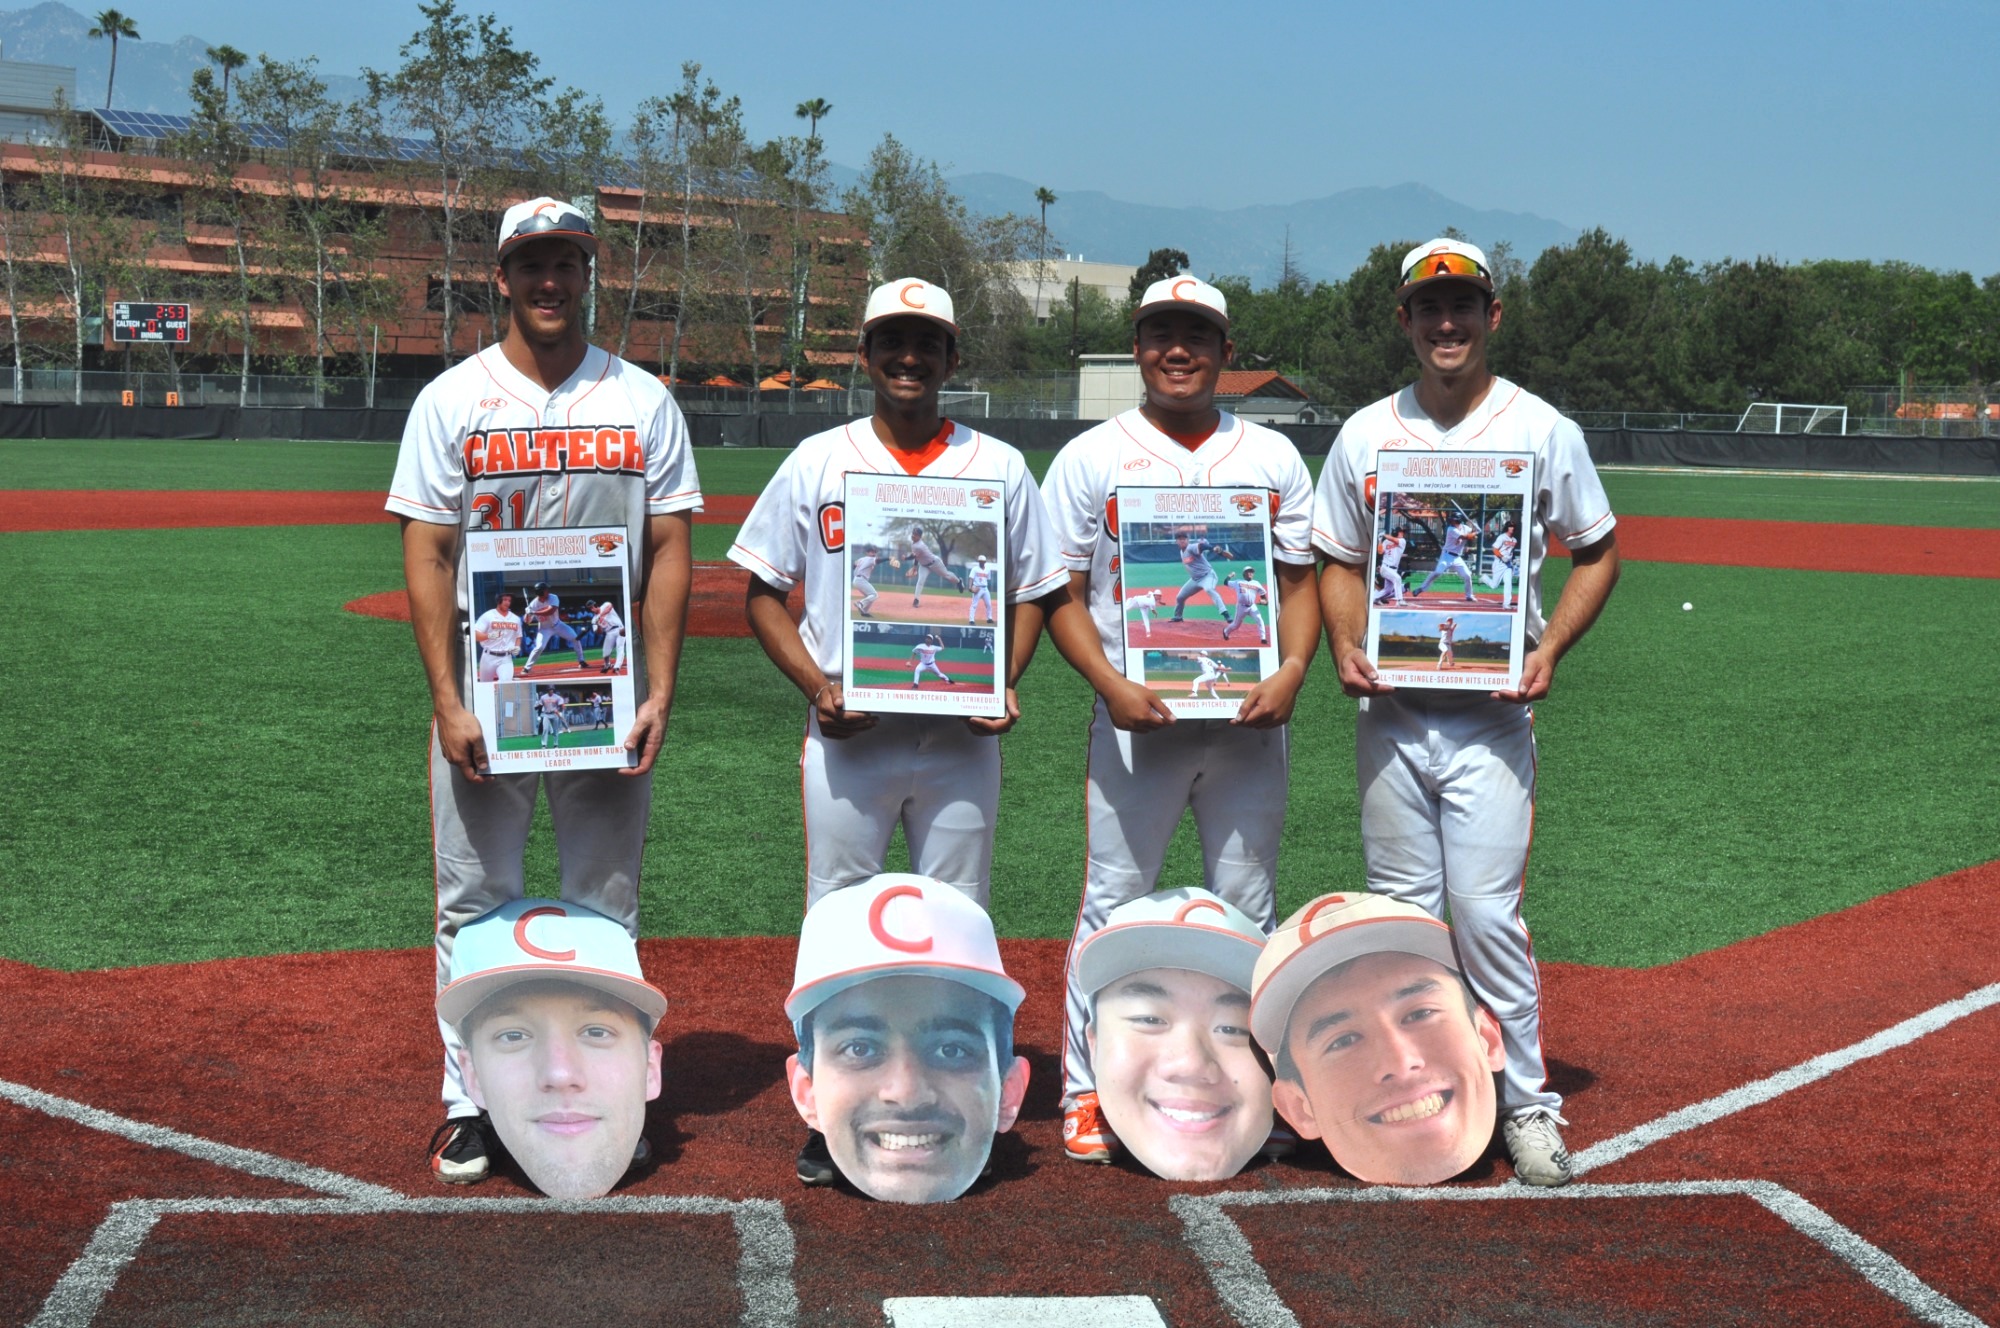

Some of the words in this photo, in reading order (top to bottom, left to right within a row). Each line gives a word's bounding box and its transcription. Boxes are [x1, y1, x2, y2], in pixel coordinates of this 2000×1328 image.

[899, 283, 925, 309] C
[1172, 280, 1197, 302] C
[156, 306, 185, 319] 2:53
[140, 331, 163, 339] INNING
[147, 320, 156, 332] 0
[165, 321, 187, 329] GUEST
[176, 327, 185, 341] 8
[462, 426, 645, 482] CALTECH
[1403, 457, 1438, 477] JACK
[1440, 458, 1496, 478] WARREN
[875, 483, 910, 504] ARYA
[911, 485, 967, 507] MEVADA
[1155, 493, 1200, 513] STEVEN
[1200, 494, 1223, 512] YEE
[469, 490, 526, 531] 31
[494, 537, 527, 558] WILL
[527, 535, 587, 557] DEMBSKI
[1409, 675, 1463, 684] SINGLE-SEASON
[1465, 677, 1481, 685] HITS
[1483, 677, 1510, 685] LEADER
[893, 693, 918, 701] INNINGS
[962, 696, 1000, 704] STRIKEOUTS
[491, 752, 524, 760] ALL-TIME
[527, 748, 581, 759] SINGLE-SEASON
[584, 746, 603, 756] HOME
[605, 746, 624, 755] RUNS
[545, 759, 571, 767] LEADER
[868, 885, 933, 954] C
[513, 906, 576, 962] C
